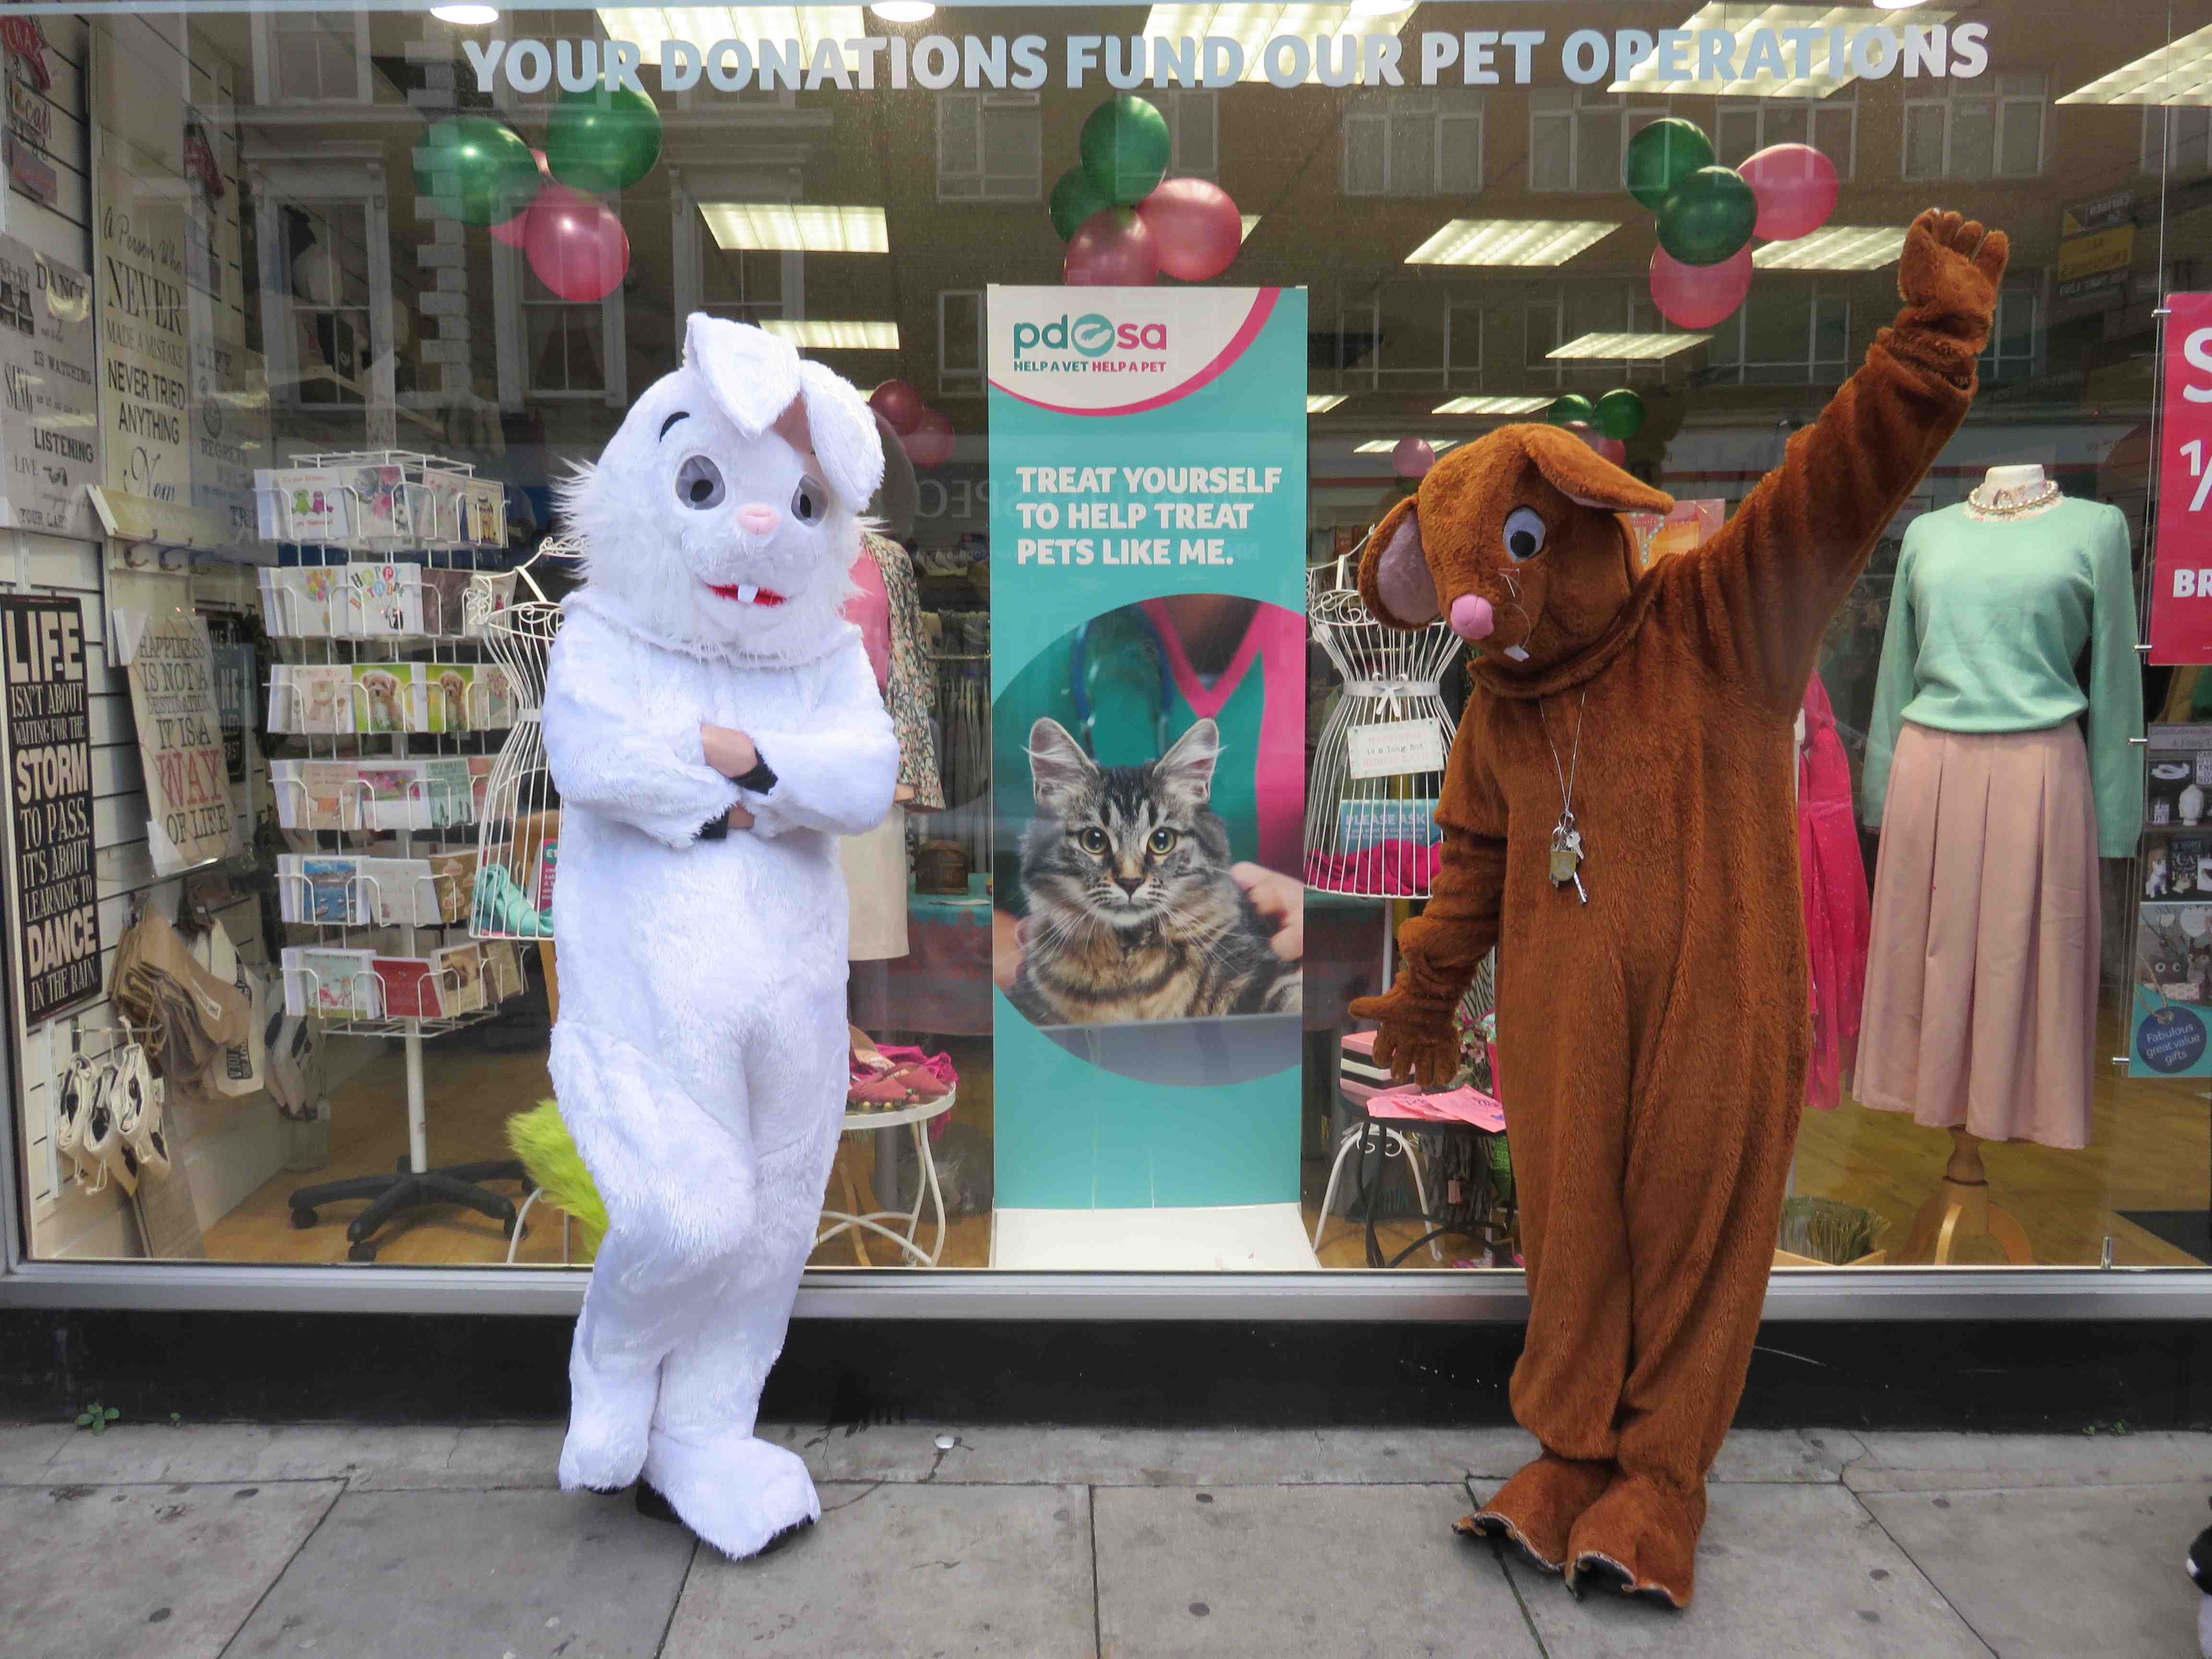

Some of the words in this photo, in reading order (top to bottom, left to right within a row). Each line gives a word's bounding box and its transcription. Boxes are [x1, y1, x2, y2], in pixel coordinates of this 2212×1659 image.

[462, 38, 641, 92] YOUR
[661, 35, 1048, 91] DONATIONS
[1066, 35, 1245, 90] FUND
[1263, 34, 1405, 89] OUR
[1421, 31, 1546, 86] PET
[1561, 23, 1989, 84] OPERATIONS
[106, 255, 184, 336] NEVER
[107, 358, 150, 400] NEVER
[153, 373, 186, 411] TRIED
[1014, 361, 1048, 372] HELP
[1050, 361, 1060, 372] A
[1062, 361, 1088, 372] VET
[1092, 361, 1127, 372] HELP
[1129, 361, 1139, 372] A
[1141, 361, 1166, 372] PET
[119, 402, 180, 445] ANYTHING
[34, 427, 94, 464] LISTENING
[15, 455, 39, 477] LIVE
[1015, 467, 1117, 493] TREAT
[1123, 467, 1283, 493] YOURSELF
[1016, 503, 1059, 529] TO
[1068, 503, 1147, 529] HELP
[1154, 503, 1254, 529] TREAT
[1018, 539, 1094, 565] PETS
[1103, 539, 1171, 565] LIKE
[1179, 539, 1234, 565] ME.
[5, 611, 83, 684] LIFE
[139, 636, 207, 660] HAPPINESS
[140, 662, 159, 692] IS
[160, 661, 195, 692] NOT
[197, 664, 210, 691] A
[10, 685, 44, 719] ISN'T
[47, 682, 84, 714] ABOUT
[12, 720, 49, 747] WAITING
[50, 717, 69, 743] FOR
[70, 714, 85, 739] THE
[156, 719, 173, 750] IT
[177, 717, 197, 748] IS
[197, 718, 212, 745] A
[16, 743, 89, 805] STORM
[156, 749, 224, 808] WAY
[20, 807, 43, 851] TO
[48, 797, 90, 844] PASS.
[166, 810, 187, 846] OF
[1346, 814, 1395, 825] PLEASE
[1400, 814, 1426, 825] ASK
[22, 849, 48, 890] IT'S
[51, 838, 91, 880] ABOUT
[24, 880, 78, 923] LEARNING
[80, 874, 93, 903] TO
[26, 904, 96, 976] DANCE
[31, 977, 46, 1011] IN
[47, 968, 69, 1004] THE
[2146, 1023, 2194, 1044] Fabulous
[2146, 1042, 2173, 1059] great
[2173, 1034, 2201, 1048] value
[2165, 1050, 2188, 1066] gifts
